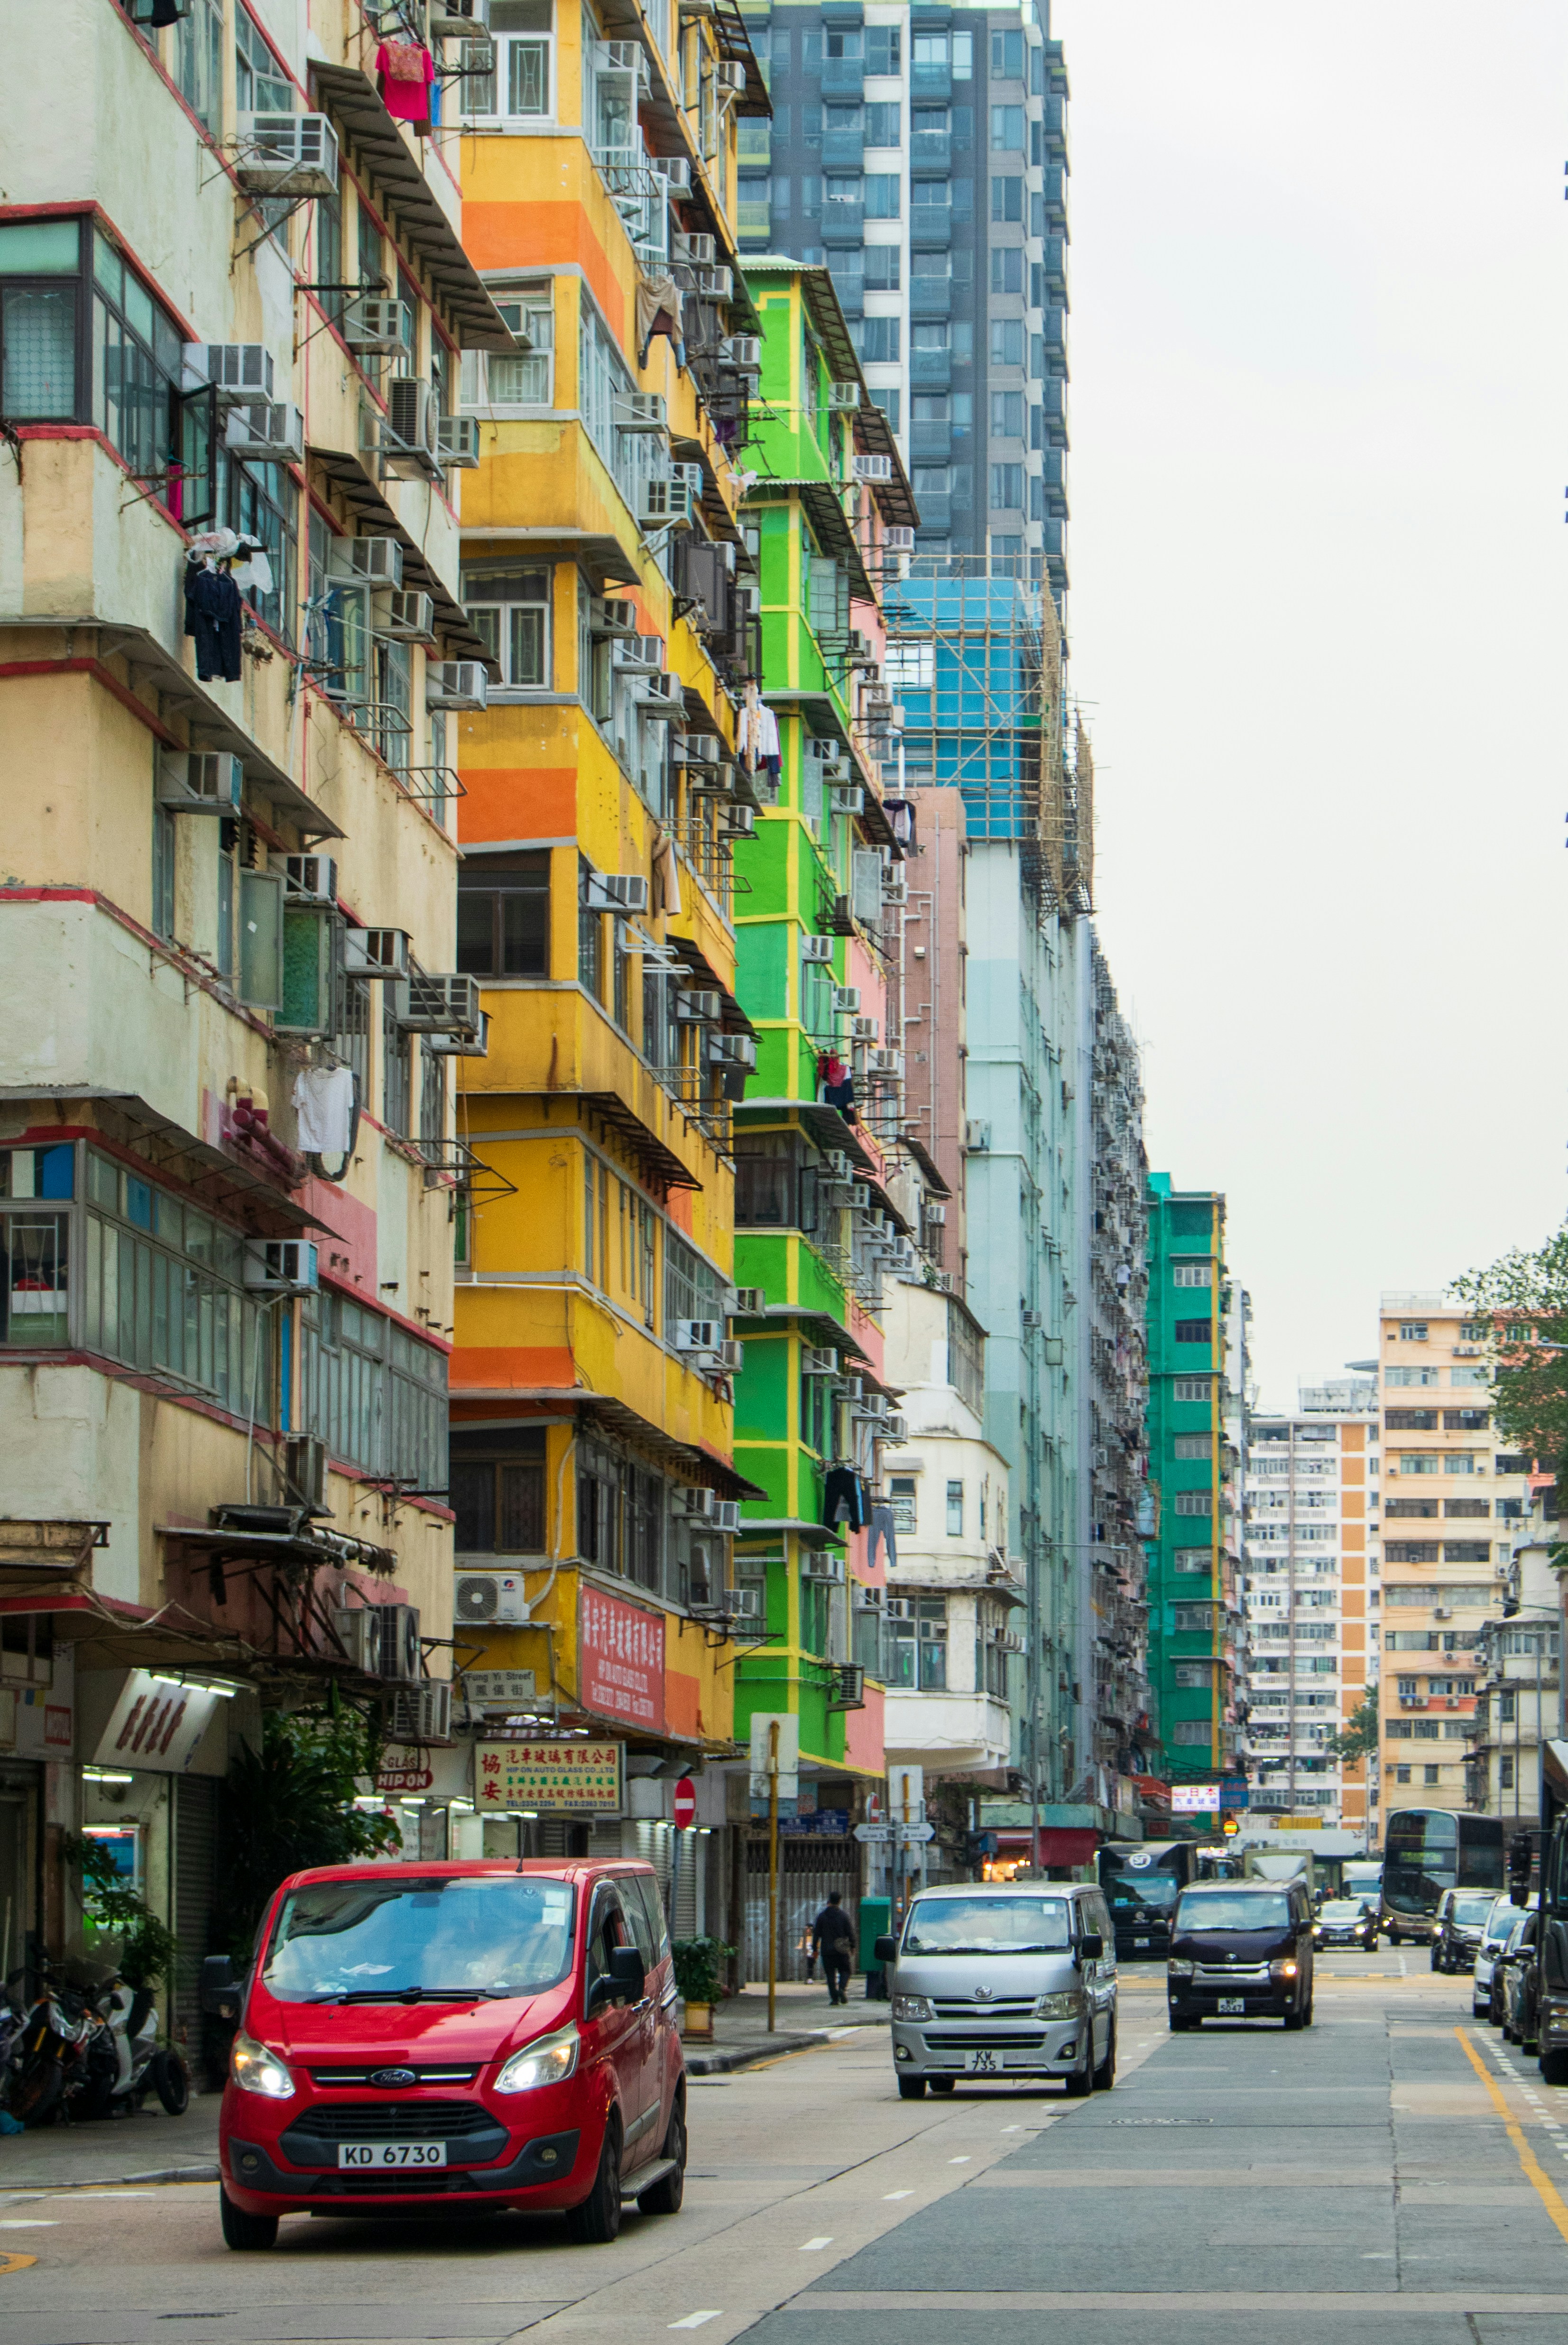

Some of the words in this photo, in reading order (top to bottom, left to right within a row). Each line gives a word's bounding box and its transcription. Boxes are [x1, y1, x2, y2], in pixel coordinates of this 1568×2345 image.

[463, 1673, 489, 1683] Fung
[493, 1672, 501, 1680] Yi
[506, 1671, 532, 1680] Street
[505, 1748, 616, 1764] 汽車玻璃有限公司
[378, 1773, 404, 1787] HIP
[406, 1773, 426, 1787] ON
[1190, 1787, 1217, 1797] 日本
[976, 2050, 992, 2061] KW
[972, 2060, 996, 2071] 735
[345, 2147, 373, 2164] KD
[383, 2146, 440, 2164] 6730
